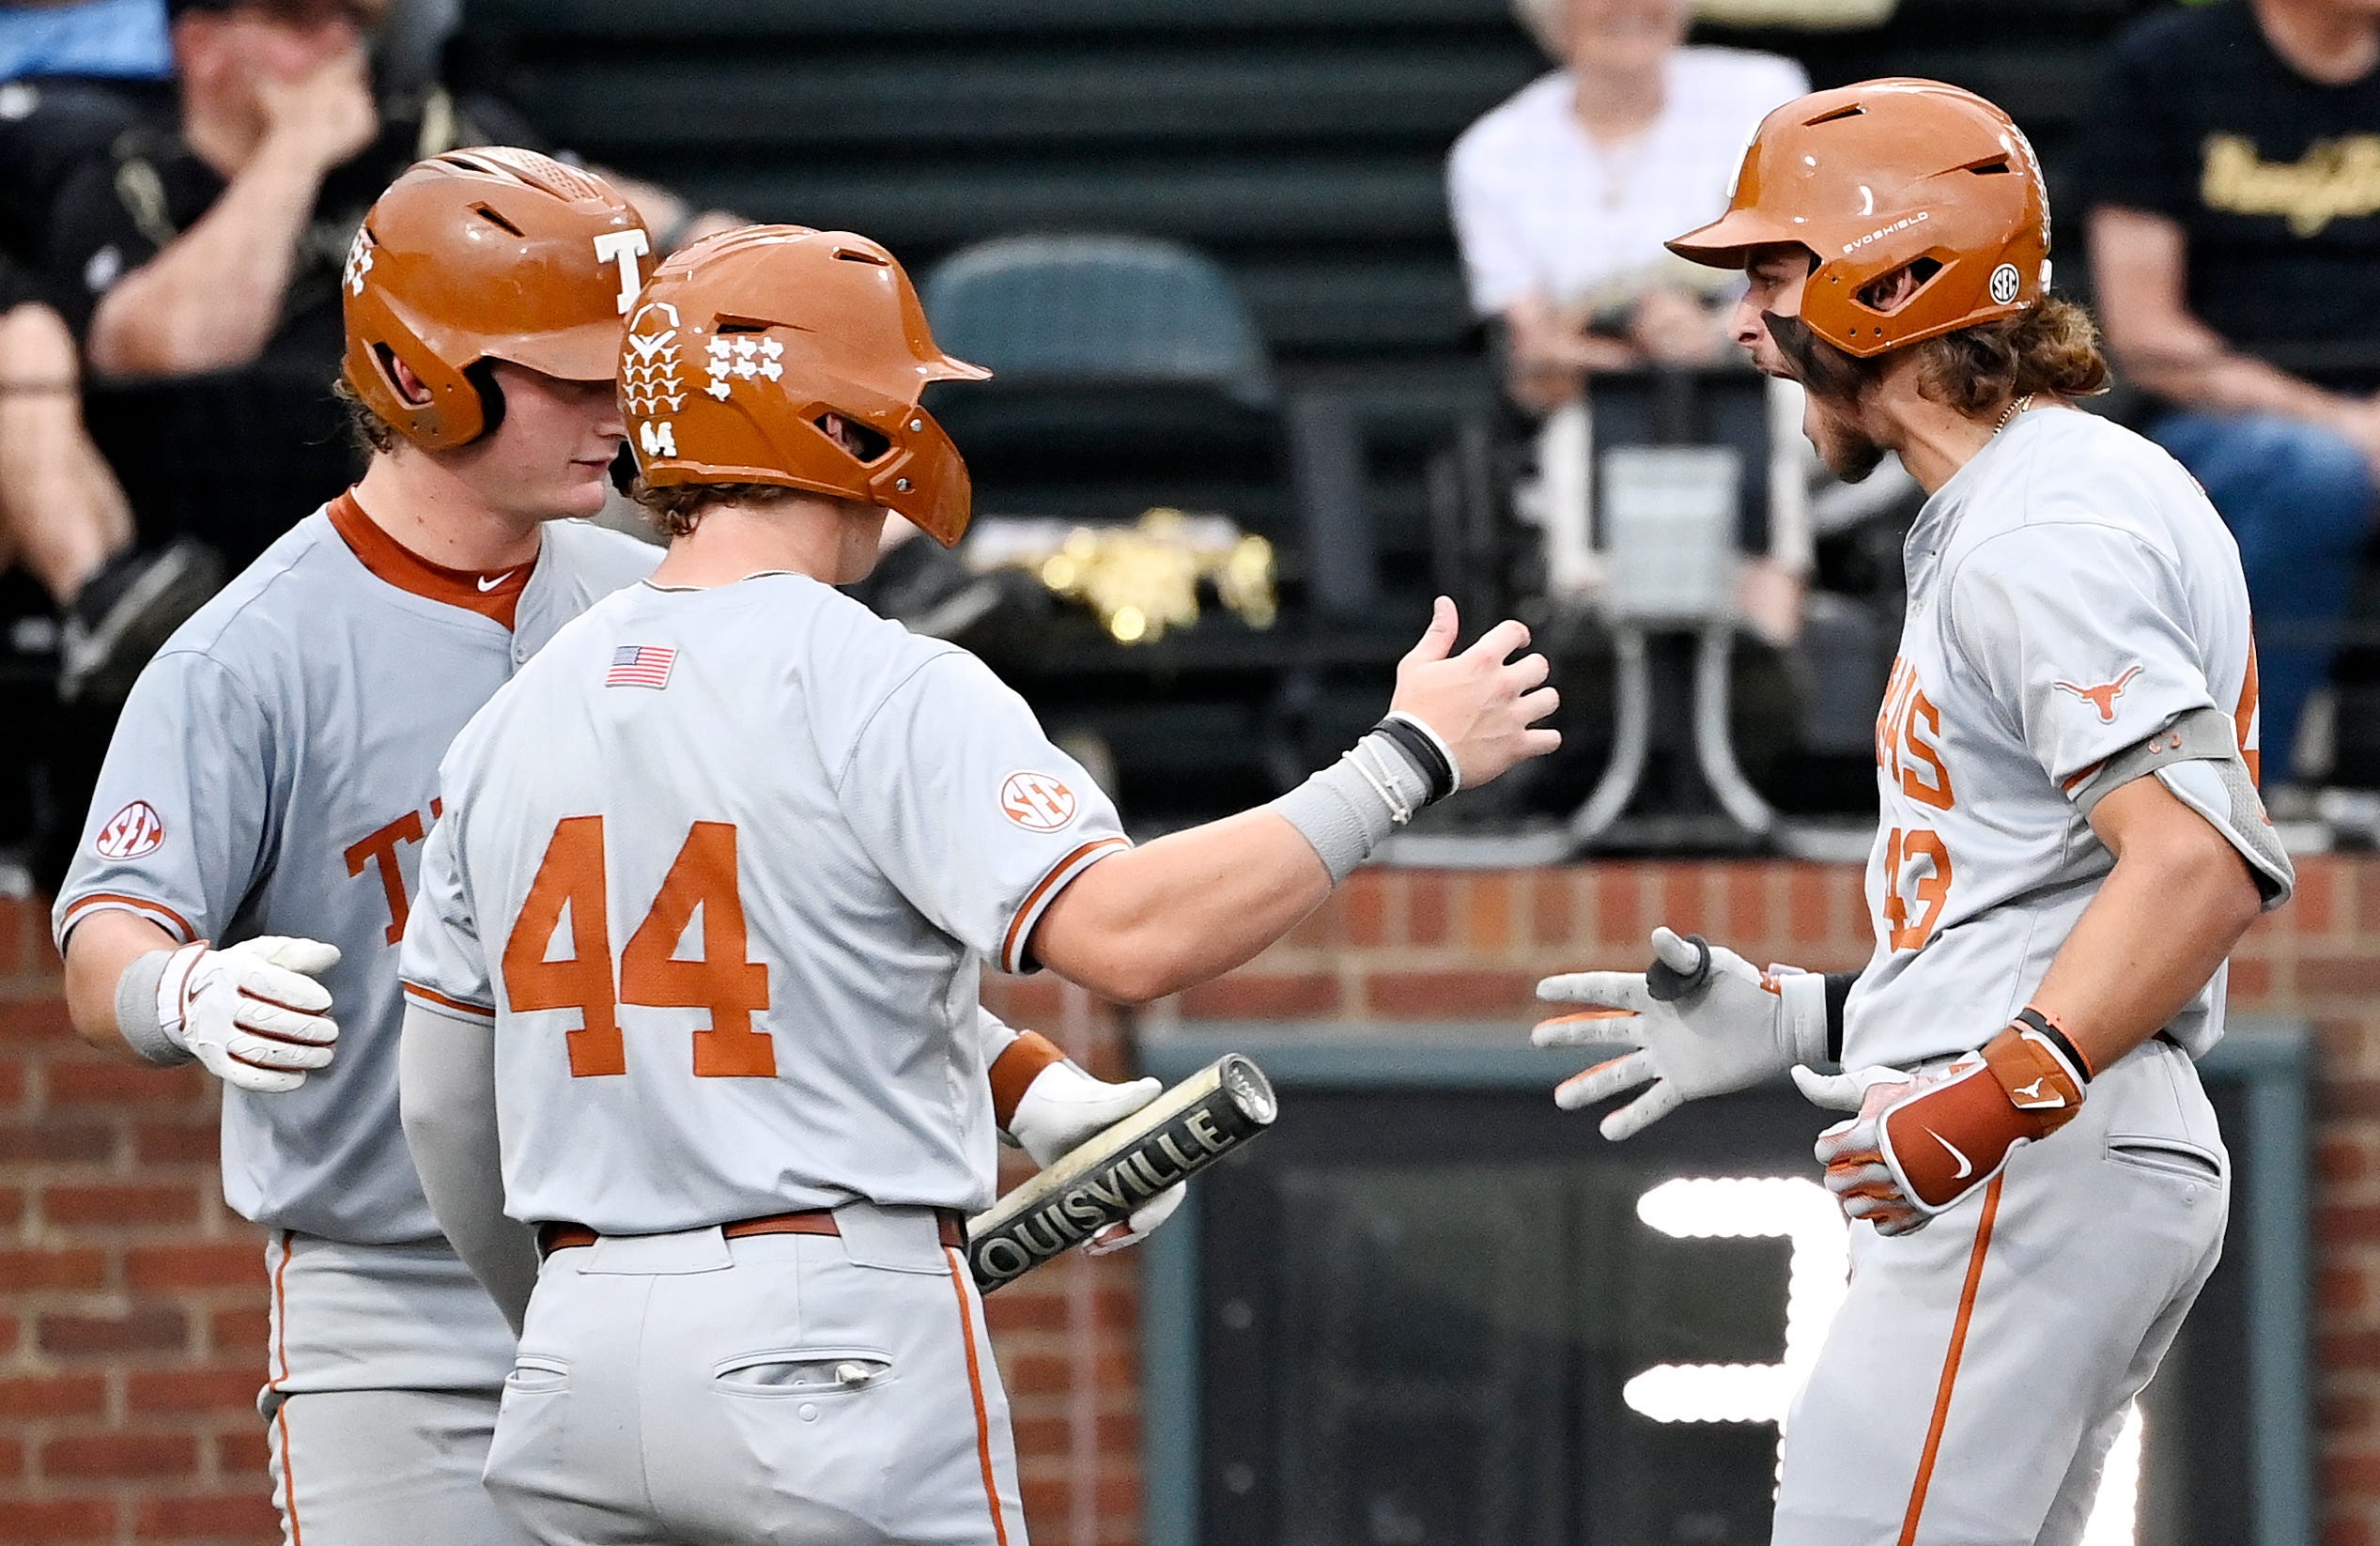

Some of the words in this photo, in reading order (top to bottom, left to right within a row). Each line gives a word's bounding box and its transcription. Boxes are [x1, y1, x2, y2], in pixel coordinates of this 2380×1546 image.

[1842, 211, 1928, 255] EVOSHIELD
[593, 228, 649, 315] T
[1992, 267, 2017, 302] SEC
[97, 803, 162, 858] SEC
[1002, 774, 1074, 827] SEC
[1883, 827, 1952, 952] 43
[502, 814, 778, 1078] 44
[977, 1108, 1236, 1289] OUISVILLE
